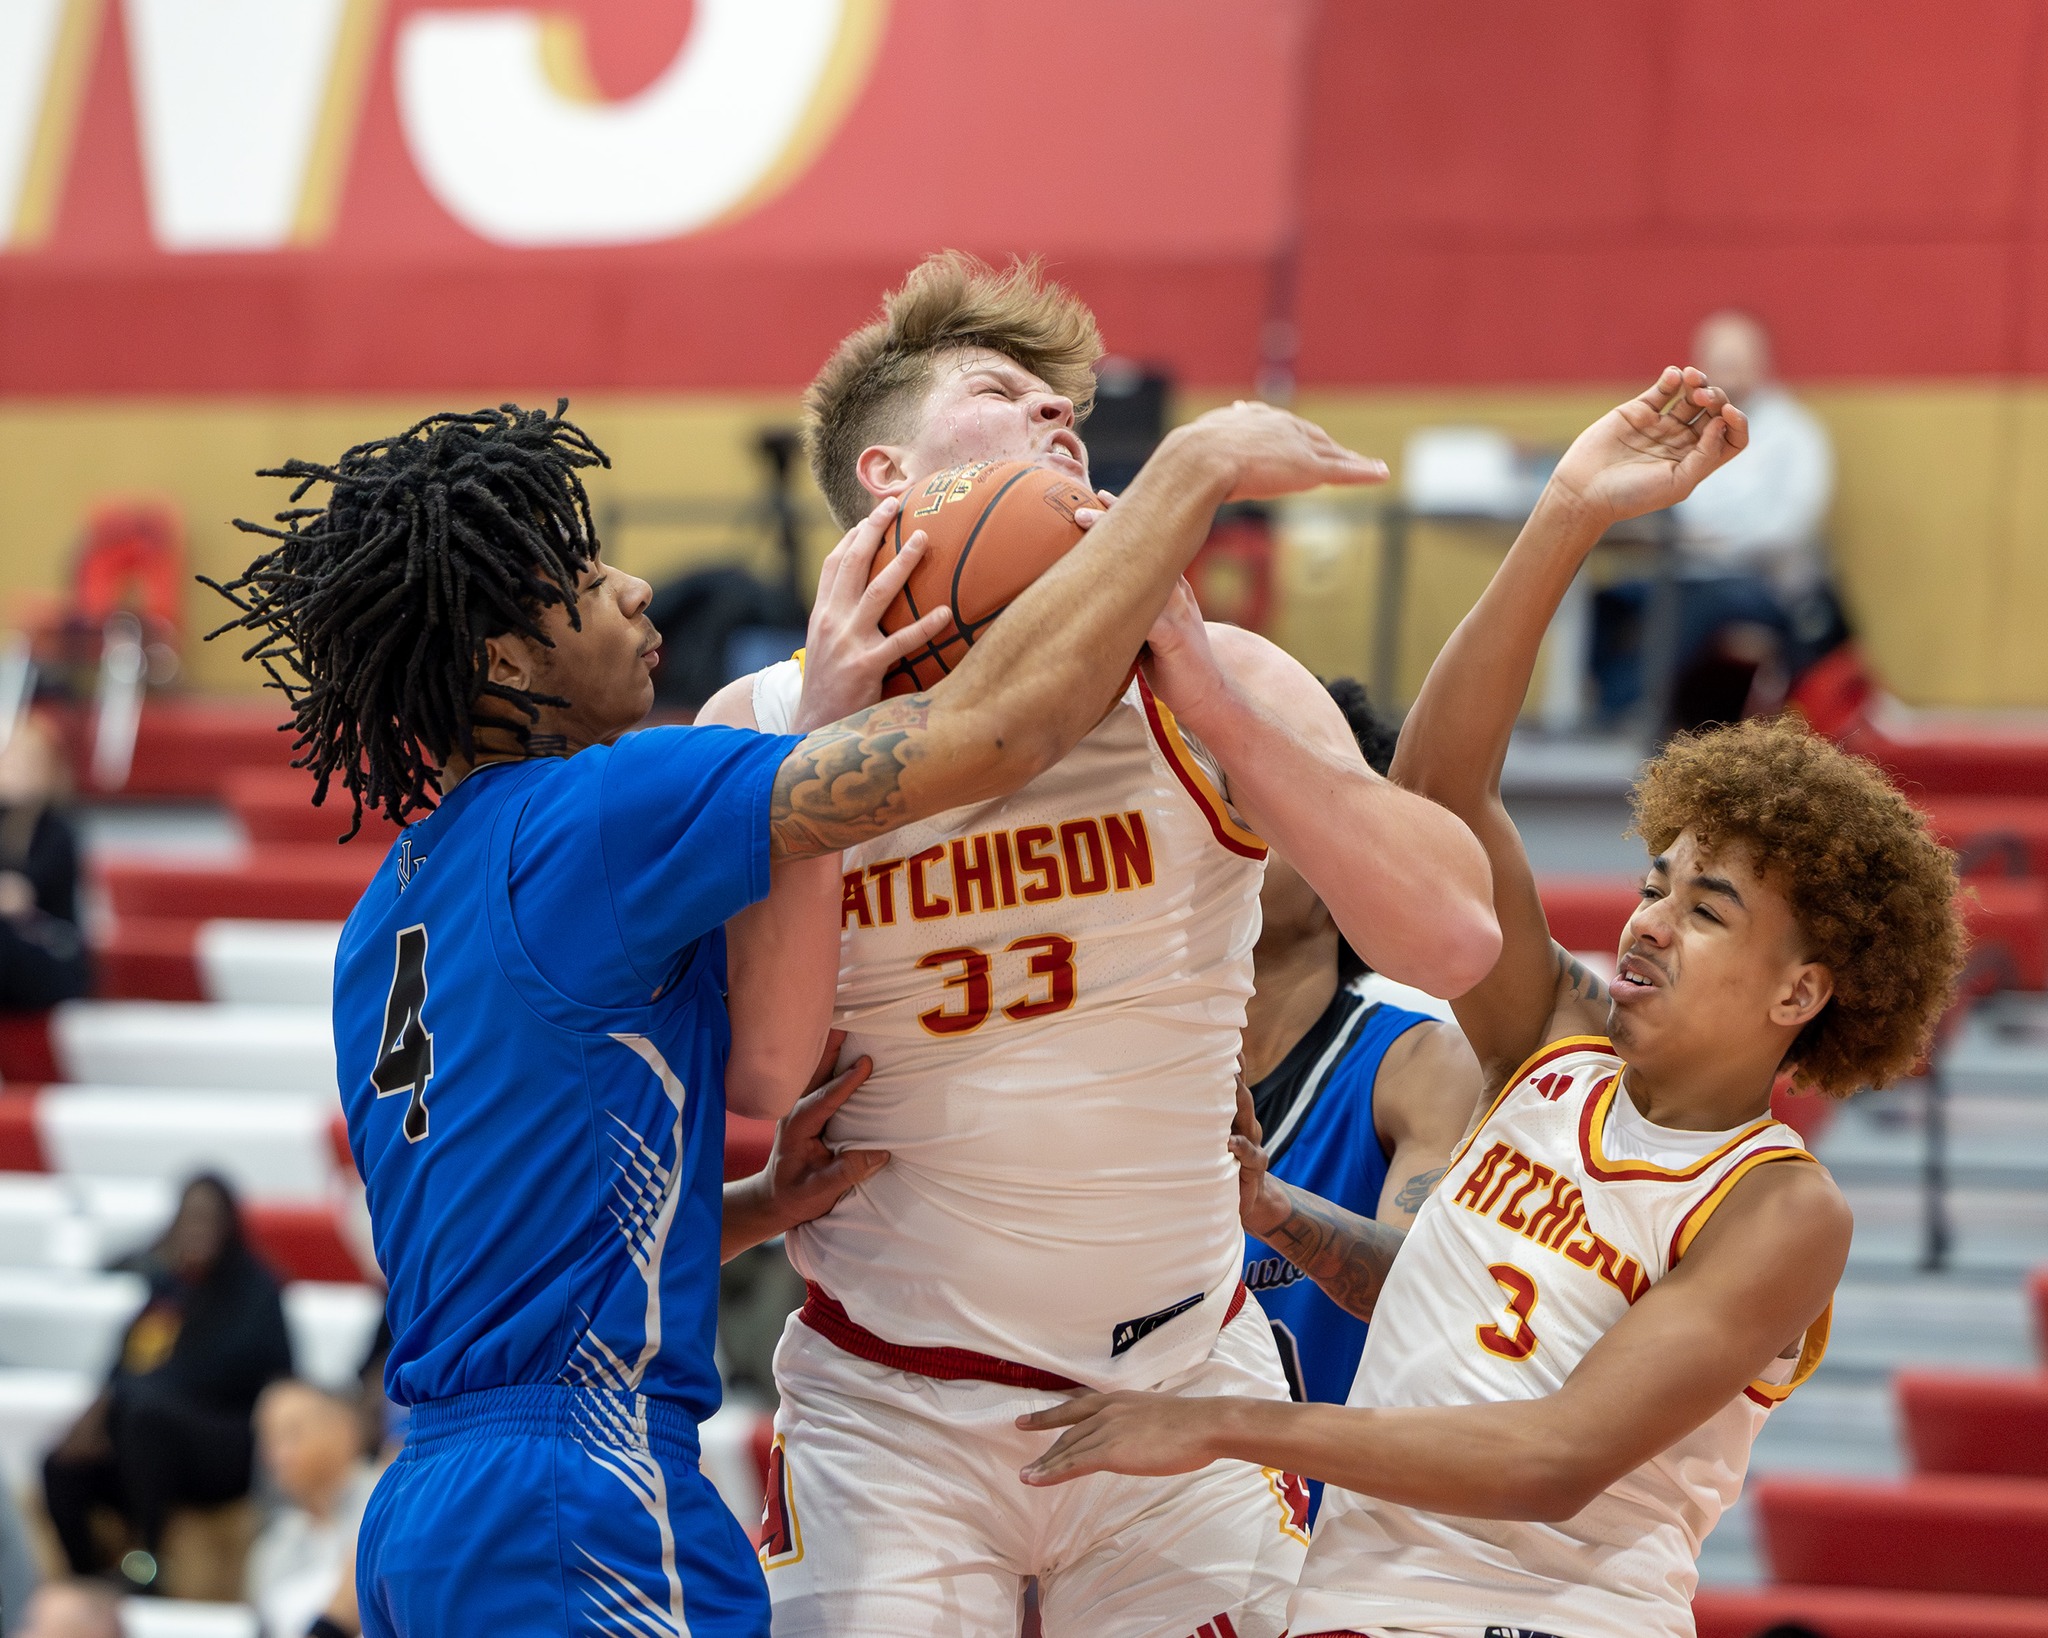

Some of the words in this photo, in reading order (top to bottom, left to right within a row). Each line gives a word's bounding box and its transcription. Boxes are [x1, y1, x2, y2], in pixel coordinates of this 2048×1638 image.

[841, 809, 1156, 932] ATCHISON
[370, 922, 434, 1144] 4
[914, 932, 1078, 1038] 33
[1475, 1262, 1539, 1362] 3
